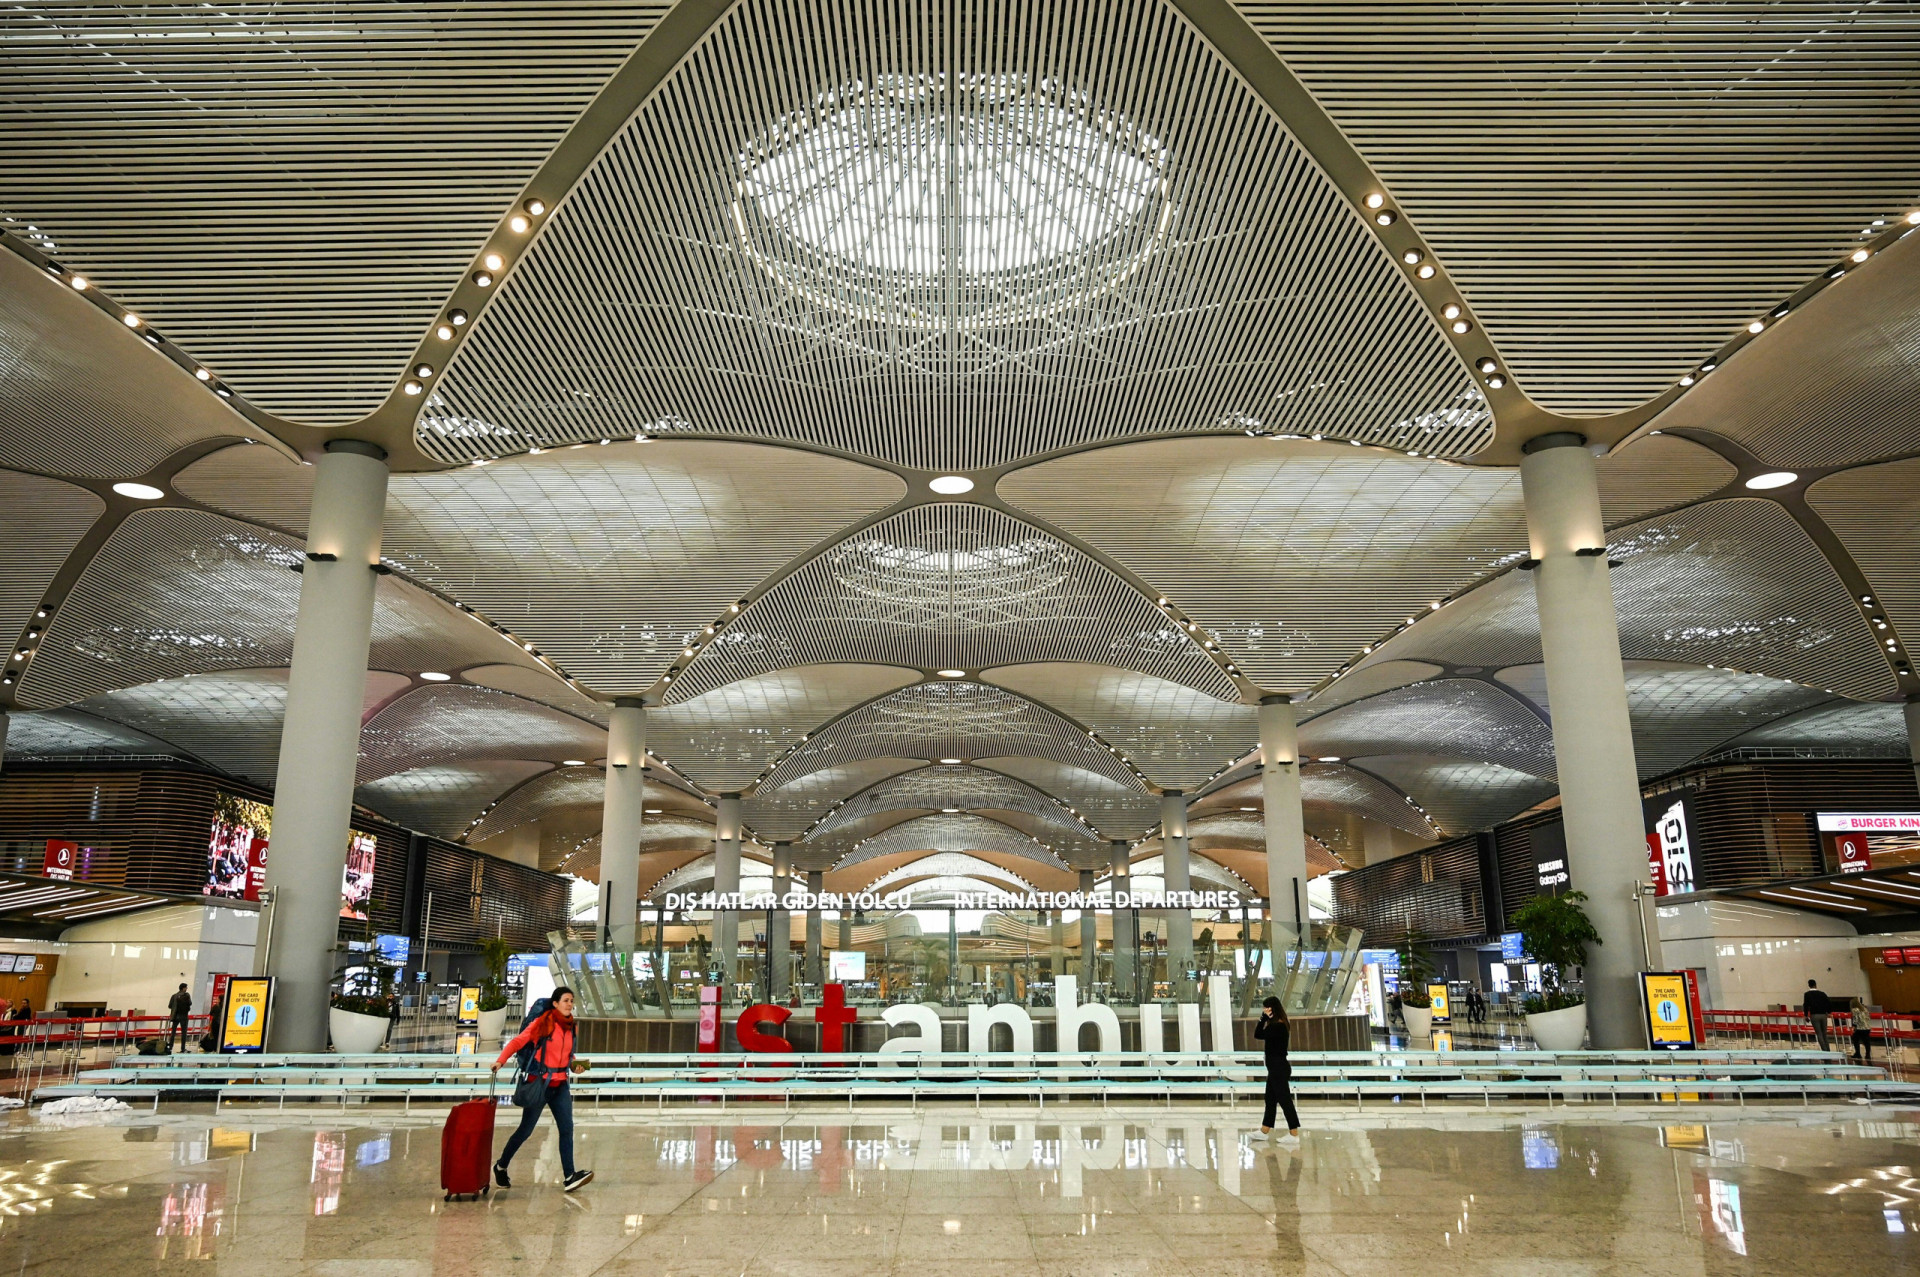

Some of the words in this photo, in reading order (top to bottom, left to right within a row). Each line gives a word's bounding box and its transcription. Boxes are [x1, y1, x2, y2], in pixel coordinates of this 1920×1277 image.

[1851, 818, 1896, 827] BURGER
[1538, 859, 1563, 873] SAMSUNG
[1540, 874, 1557, 886] Galaxy
[665, 892, 697, 914] DIŞ
[701, 892, 778, 910] HATLAR
[847, 892, 911, 910] YOLCU
[954, 891, 1111, 909] INTERNATIONAL
[1115, 890, 1240, 908] DEPARTURES
[697, 974, 1249, 1083] istanbul
